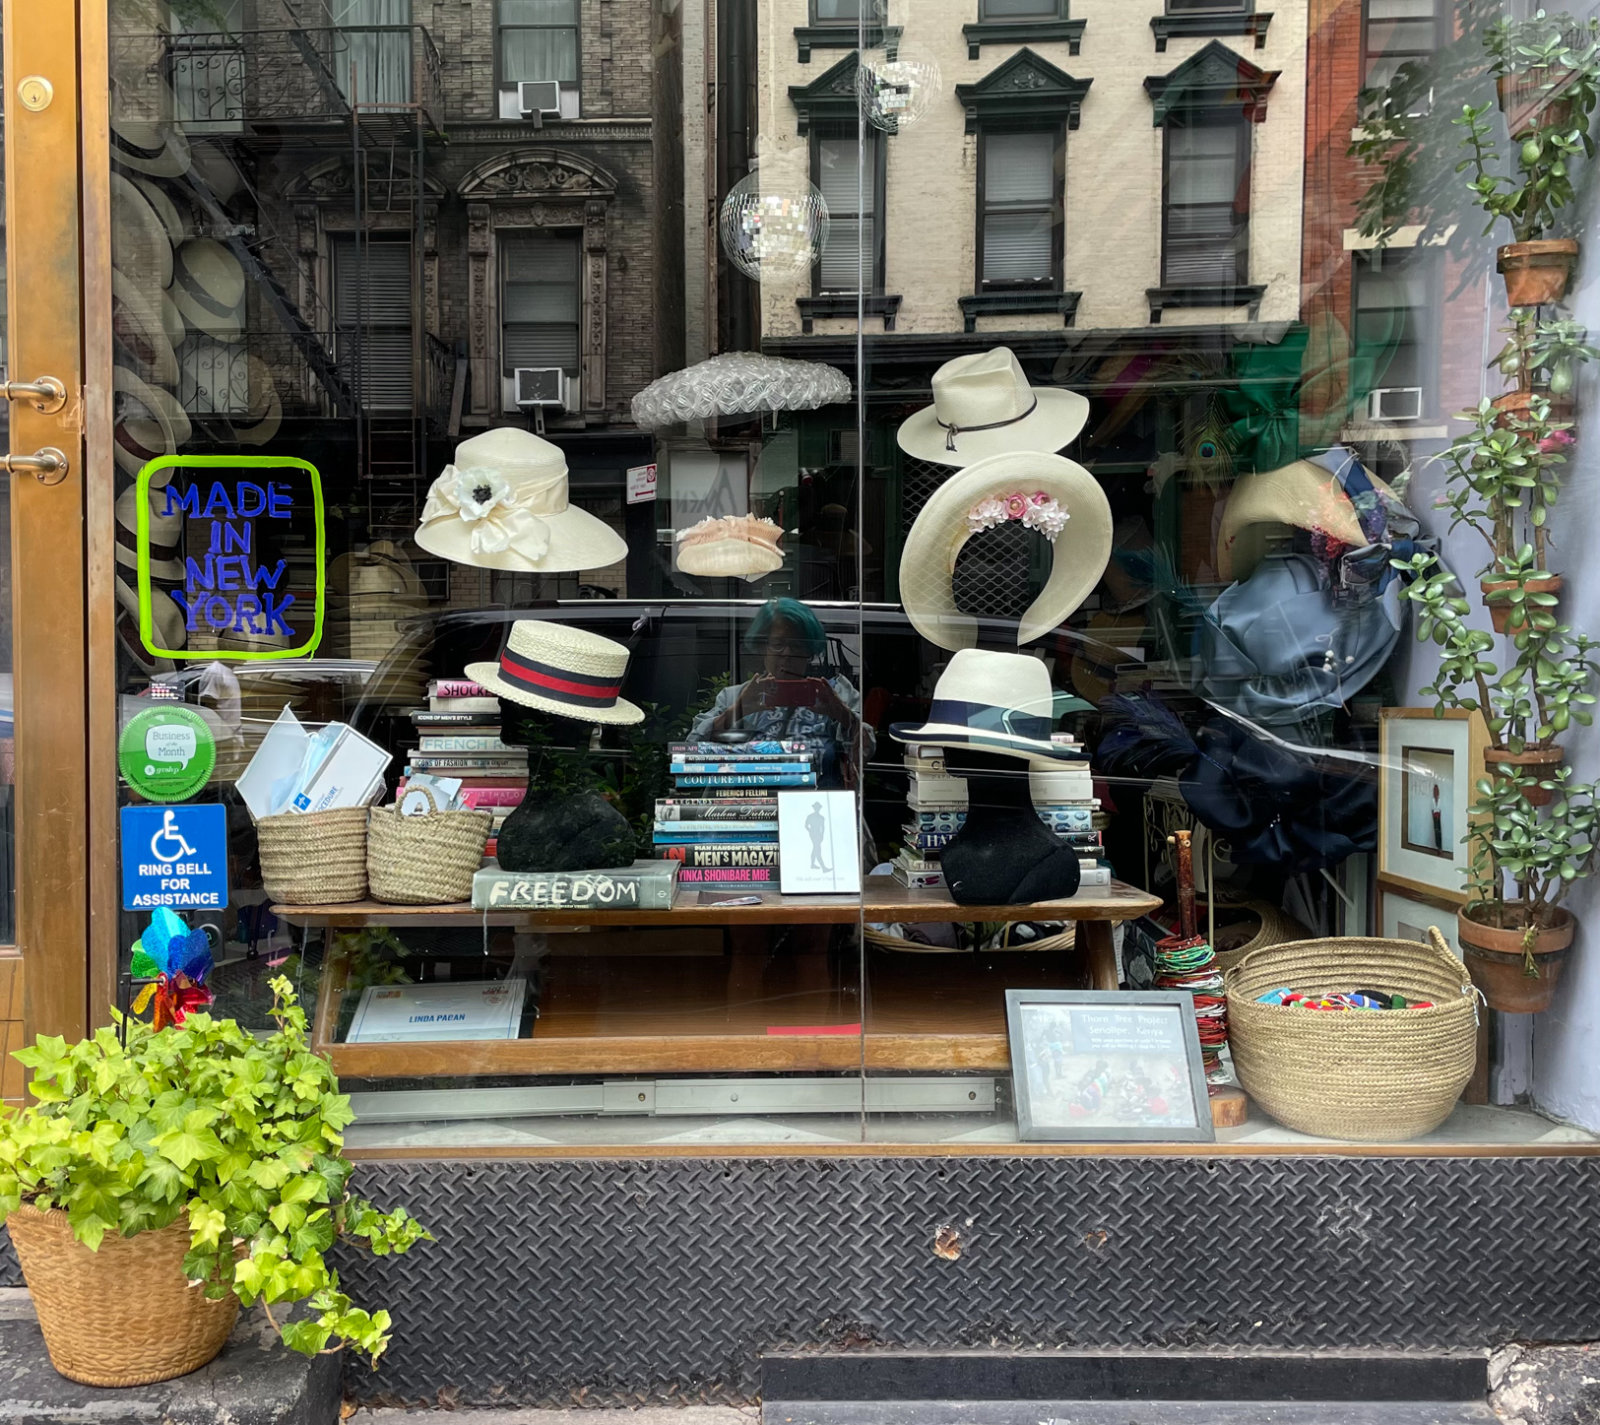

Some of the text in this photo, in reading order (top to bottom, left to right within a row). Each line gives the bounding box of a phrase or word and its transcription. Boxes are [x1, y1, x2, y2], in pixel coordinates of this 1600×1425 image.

[161, 481, 293, 519] MADE
[208, 521, 251, 554] IN
[186, 553, 287, 592] NEW
[171, 590, 296, 636] YORK
[152, 731, 191, 741] Business
[424, 739, 487, 750] FRENCH
[158, 747, 185, 757] Month
[415, 759, 433, 767] ICONS
[434, 759, 442, 767] OF
[443, 759, 468, 767] FASHION
[684, 774, 765, 785] COUTURE HATS
[716, 789, 768, 797] FEDERICO FELLINI
[697, 805, 777, 818] Marlene Dietrich
[694, 851, 779, 866] MEN'S MAGAZI
[139, 863, 212, 876] RING BELL
[679, 868, 770, 882] YINKA SHONIBARE MBE
[161, 878, 190, 890] FOR
[489, 880, 637, 905] FREEDOM
[132, 893, 219, 906] ASSISTANCE
[408, 1015, 434, 1023] LINDA
[1081, 1014, 1168, 1025] Thorn Tree Project
